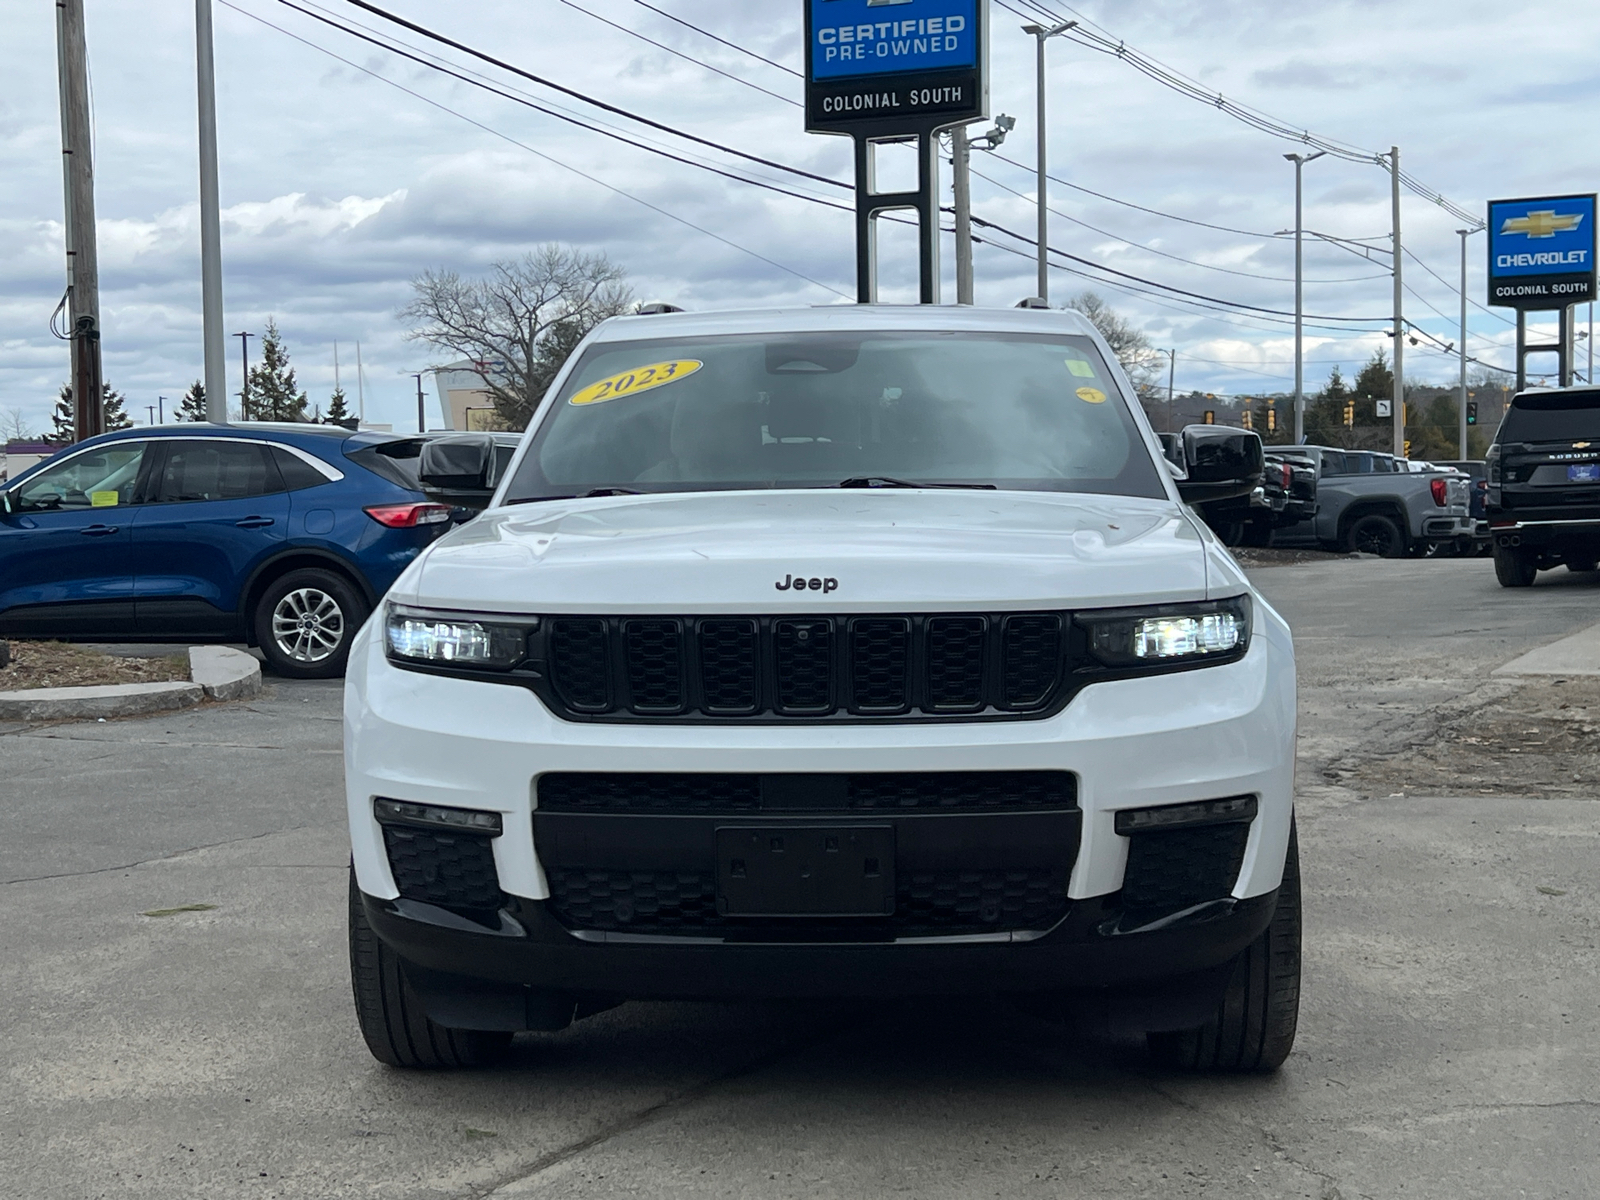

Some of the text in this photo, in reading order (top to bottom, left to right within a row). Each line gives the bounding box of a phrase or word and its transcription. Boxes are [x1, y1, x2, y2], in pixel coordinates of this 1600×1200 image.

[818, 15, 965, 45] CERTIFIED
[826, 35, 958, 62] PRE-OWNED
[823, 86, 962, 112] COLONIAL SOUTH
[1497, 250, 1588, 268] CHEVROLET
[1496, 283, 1588, 297] COLONIAL SOUTH
[592, 363, 678, 401] 2023
[775, 574, 838, 594] Jeep
